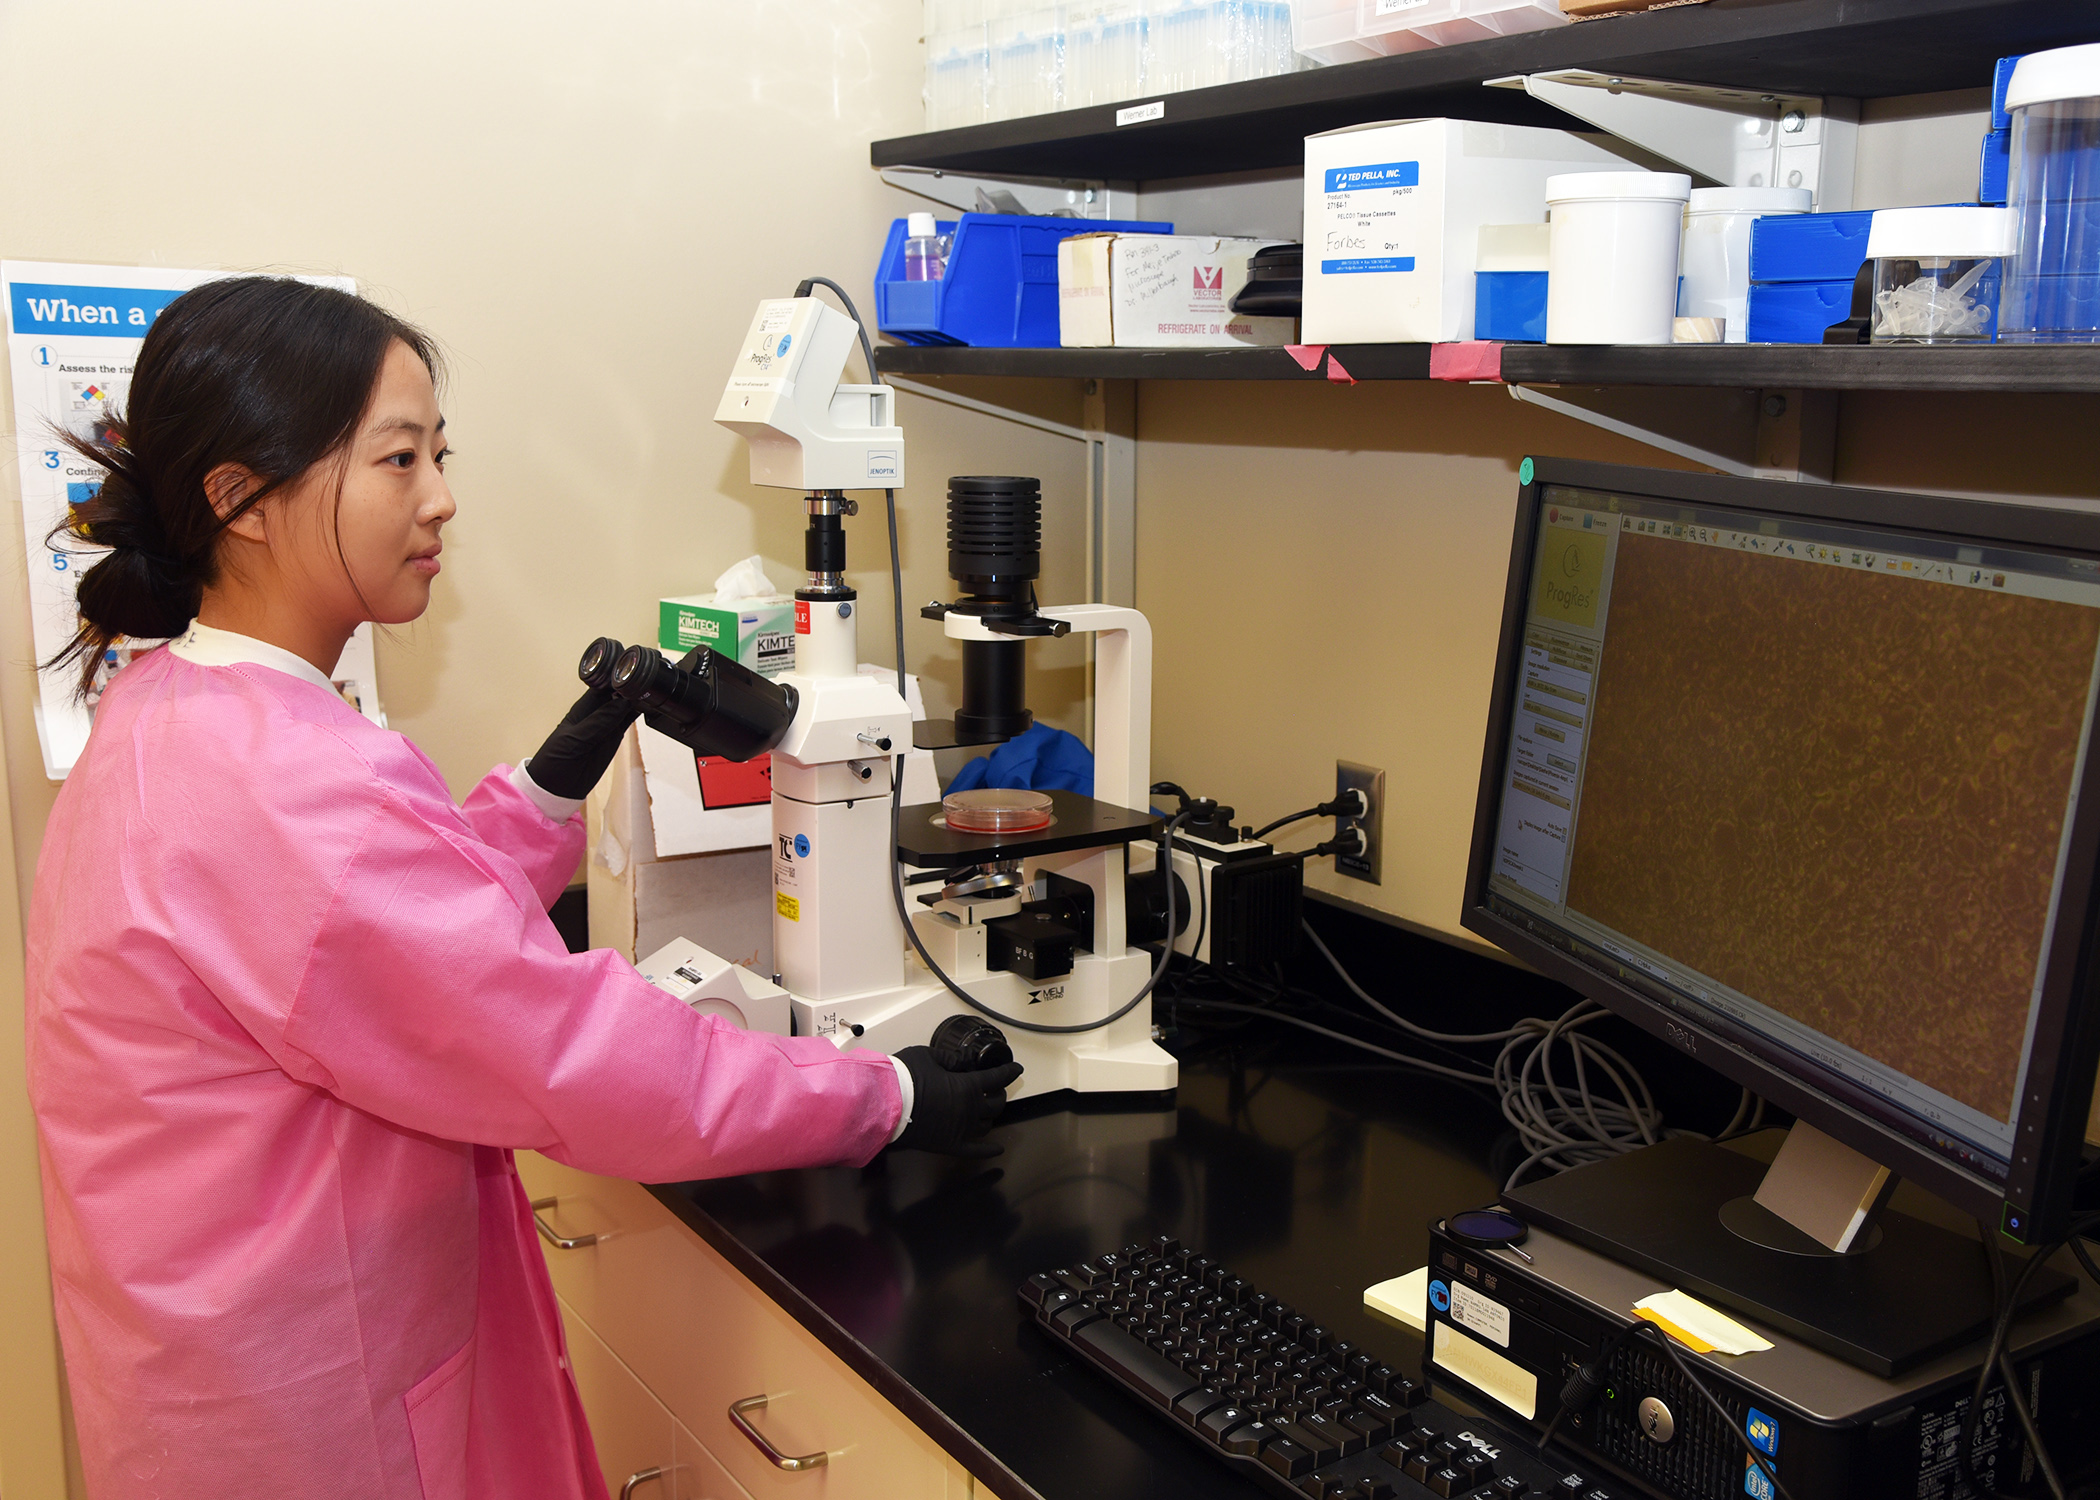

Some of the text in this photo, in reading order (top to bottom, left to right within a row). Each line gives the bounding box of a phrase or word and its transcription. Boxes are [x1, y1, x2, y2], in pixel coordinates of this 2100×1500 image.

[1123, 107, 1157, 120] Werner Lab
[1348, 169, 1400, 182] TED PELLA, INC.
[1393, 188, 1412, 196] pkg/500
[1327, 231, 1366, 251] Forbes
[27, 298, 147, 325] When a
[1158, 324, 1253, 335] REFRIGERATE ON ARRIVAL
[40, 347, 49, 365] 1
[59, 364, 135, 374] Assess the ris
[45, 451, 60, 469] 3
[1559, 513, 1574, 522] Capture
[1593, 518, 1607, 527] Freeze
[53, 554, 68, 571] 5
[1546, 581, 1590, 609] ProgRes
[678, 616, 720, 632] KIMTECH
[757, 635, 795, 652] KIMTE
[1043, 986, 1064, 998] MEIJI
[1043, 993, 1064, 1002] TECHNO
[1665, 1022, 1697, 1053] DELL
[1485, 1273, 1498, 1283] DVD
[1360, 1355, 1370, 1363] F10
[1402, 1380, 1413, 1388] F12
[1421, 1427, 1434, 1436] Insert
[1396, 1441, 1410, 1450] Delete
[1444, 1441, 1457, 1450] Home
[1457, 1431, 1502, 1460] DELL
[1768, 1428, 1776, 1452] Windows
[1472, 1453, 1483, 1462] Page
[1501, 1478, 1514, 1488] Lock
[1506, 1475, 1520, 1485] Num
[1760, 1480, 1769, 1500] CORE
